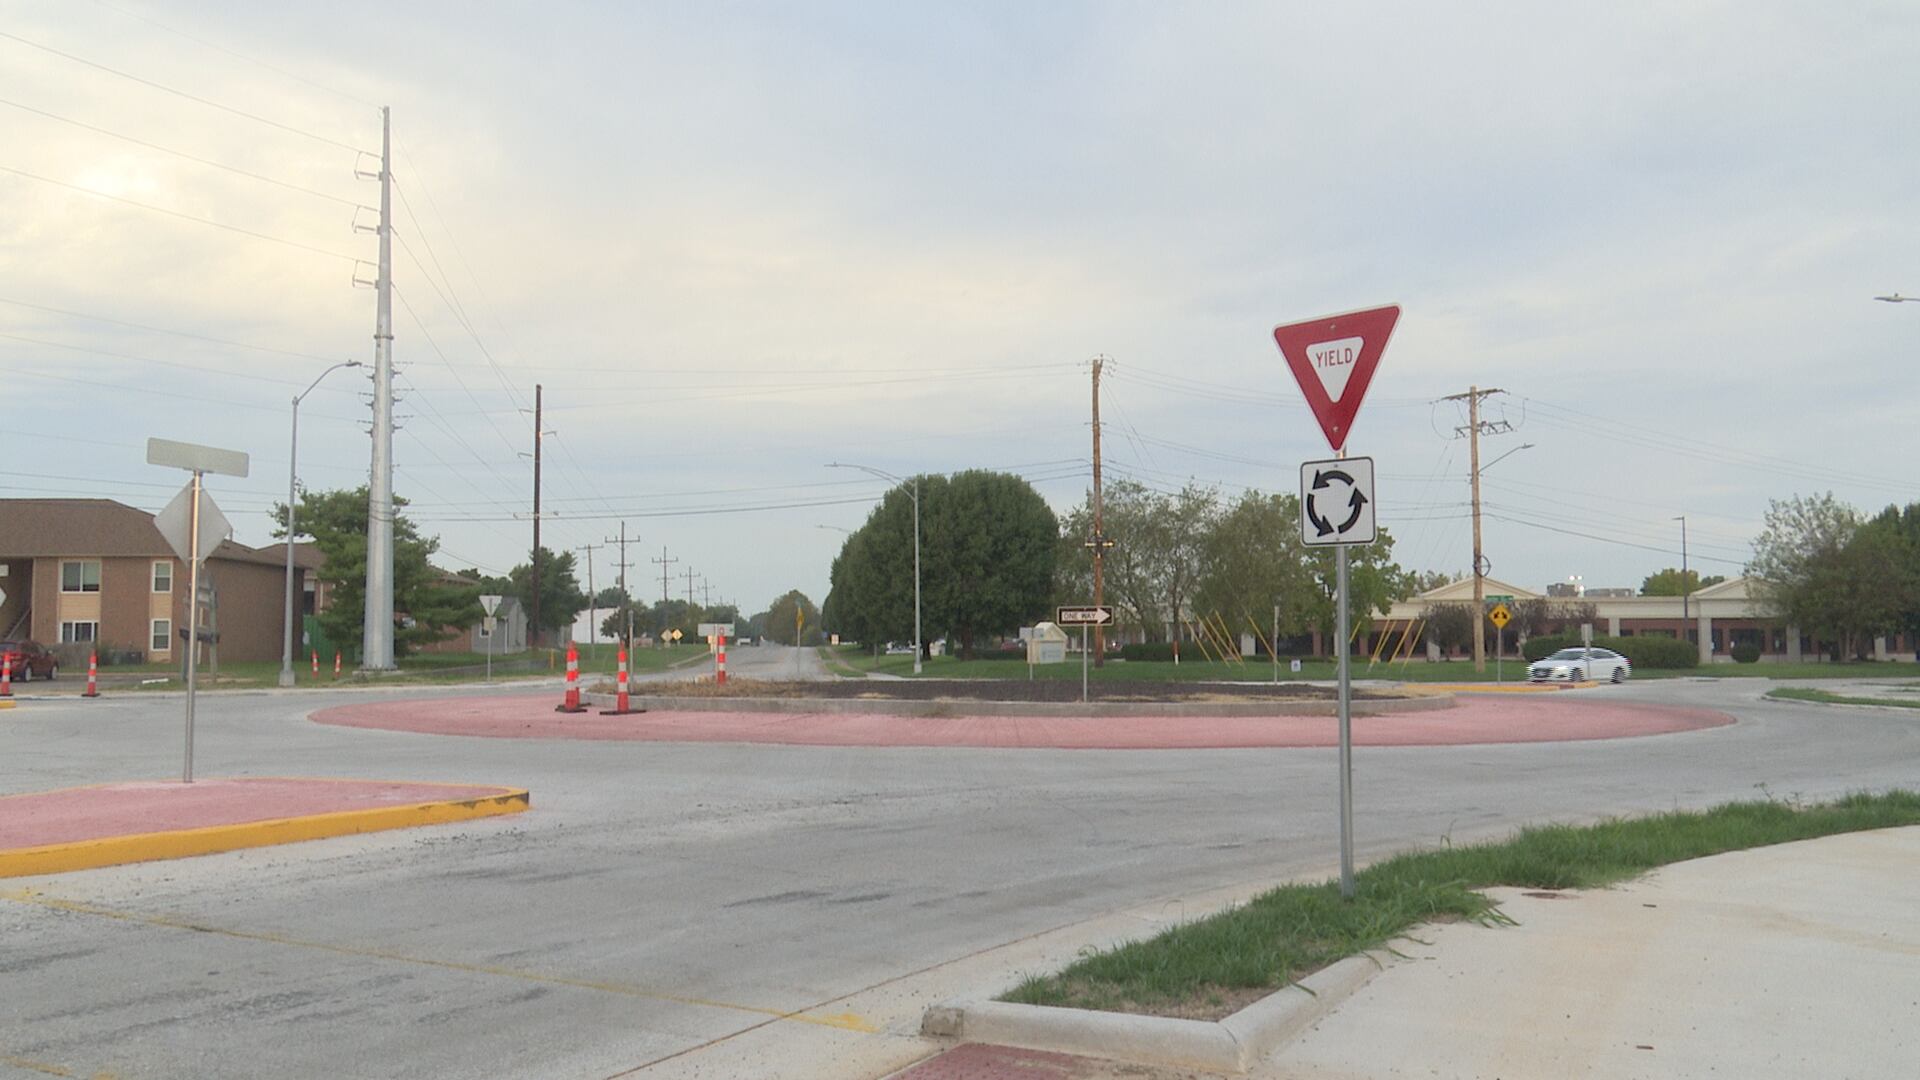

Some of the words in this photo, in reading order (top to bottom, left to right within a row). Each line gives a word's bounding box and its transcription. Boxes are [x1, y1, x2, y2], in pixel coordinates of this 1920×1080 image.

[1315, 348, 1353, 368] YIELD
[1063, 612, 1078, 620] ONE
[1081, 612, 1096, 620] WAY
